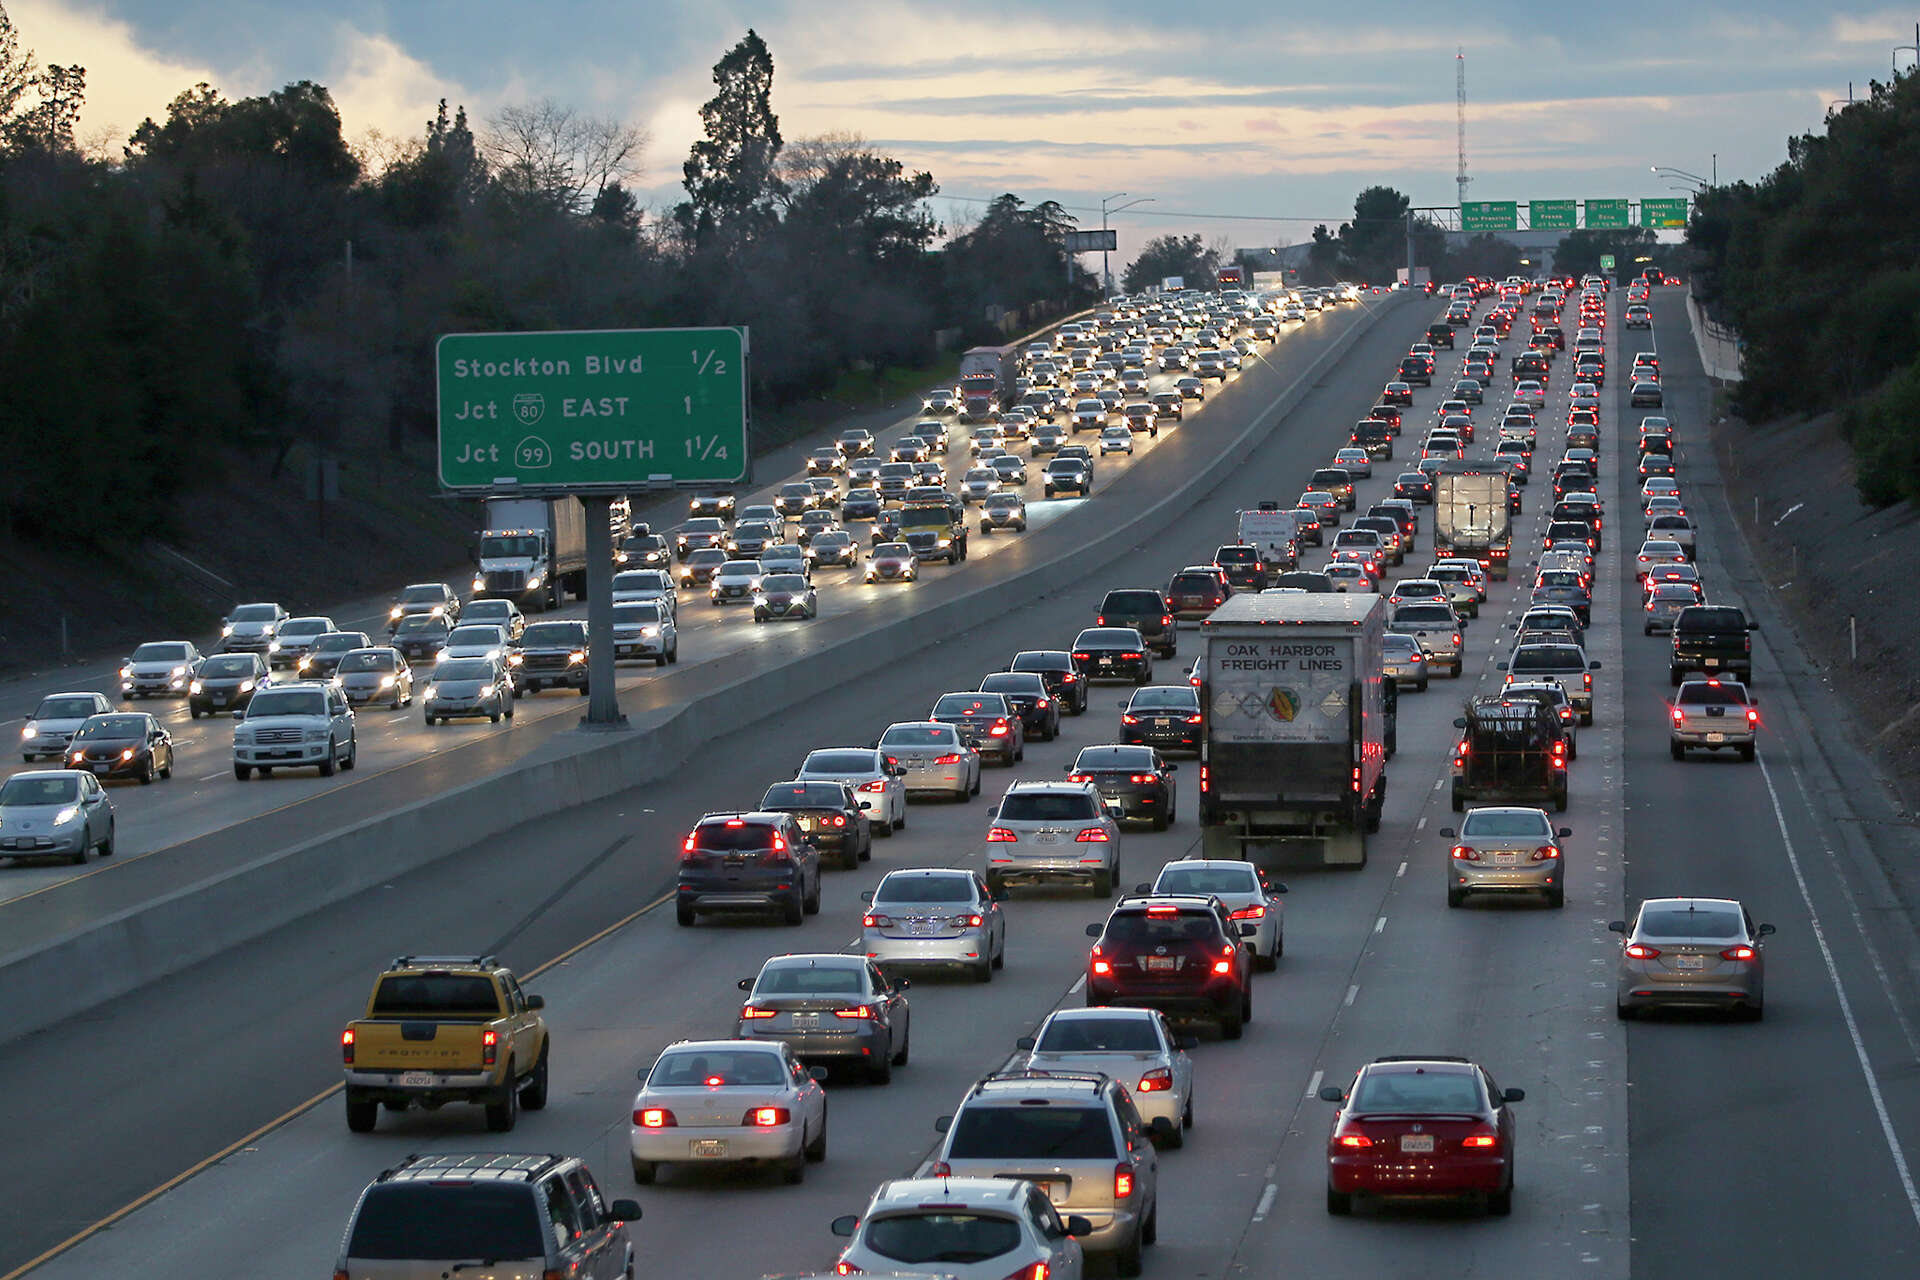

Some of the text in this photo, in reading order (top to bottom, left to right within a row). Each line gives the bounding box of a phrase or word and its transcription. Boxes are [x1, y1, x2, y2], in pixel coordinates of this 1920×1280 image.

[453, 349, 727, 378] Stockton Blvd 1/2
[454, 395, 692, 420] Jct 80 EAST 1
[456, 443, 500, 464] Jct
[522, 448, 544, 462] 99
[569, 440, 655, 461] SOUTH
[1227, 645, 1336, 656] OAK HARBOR
[1221, 659, 1343, 671] FREIGHT LINES
